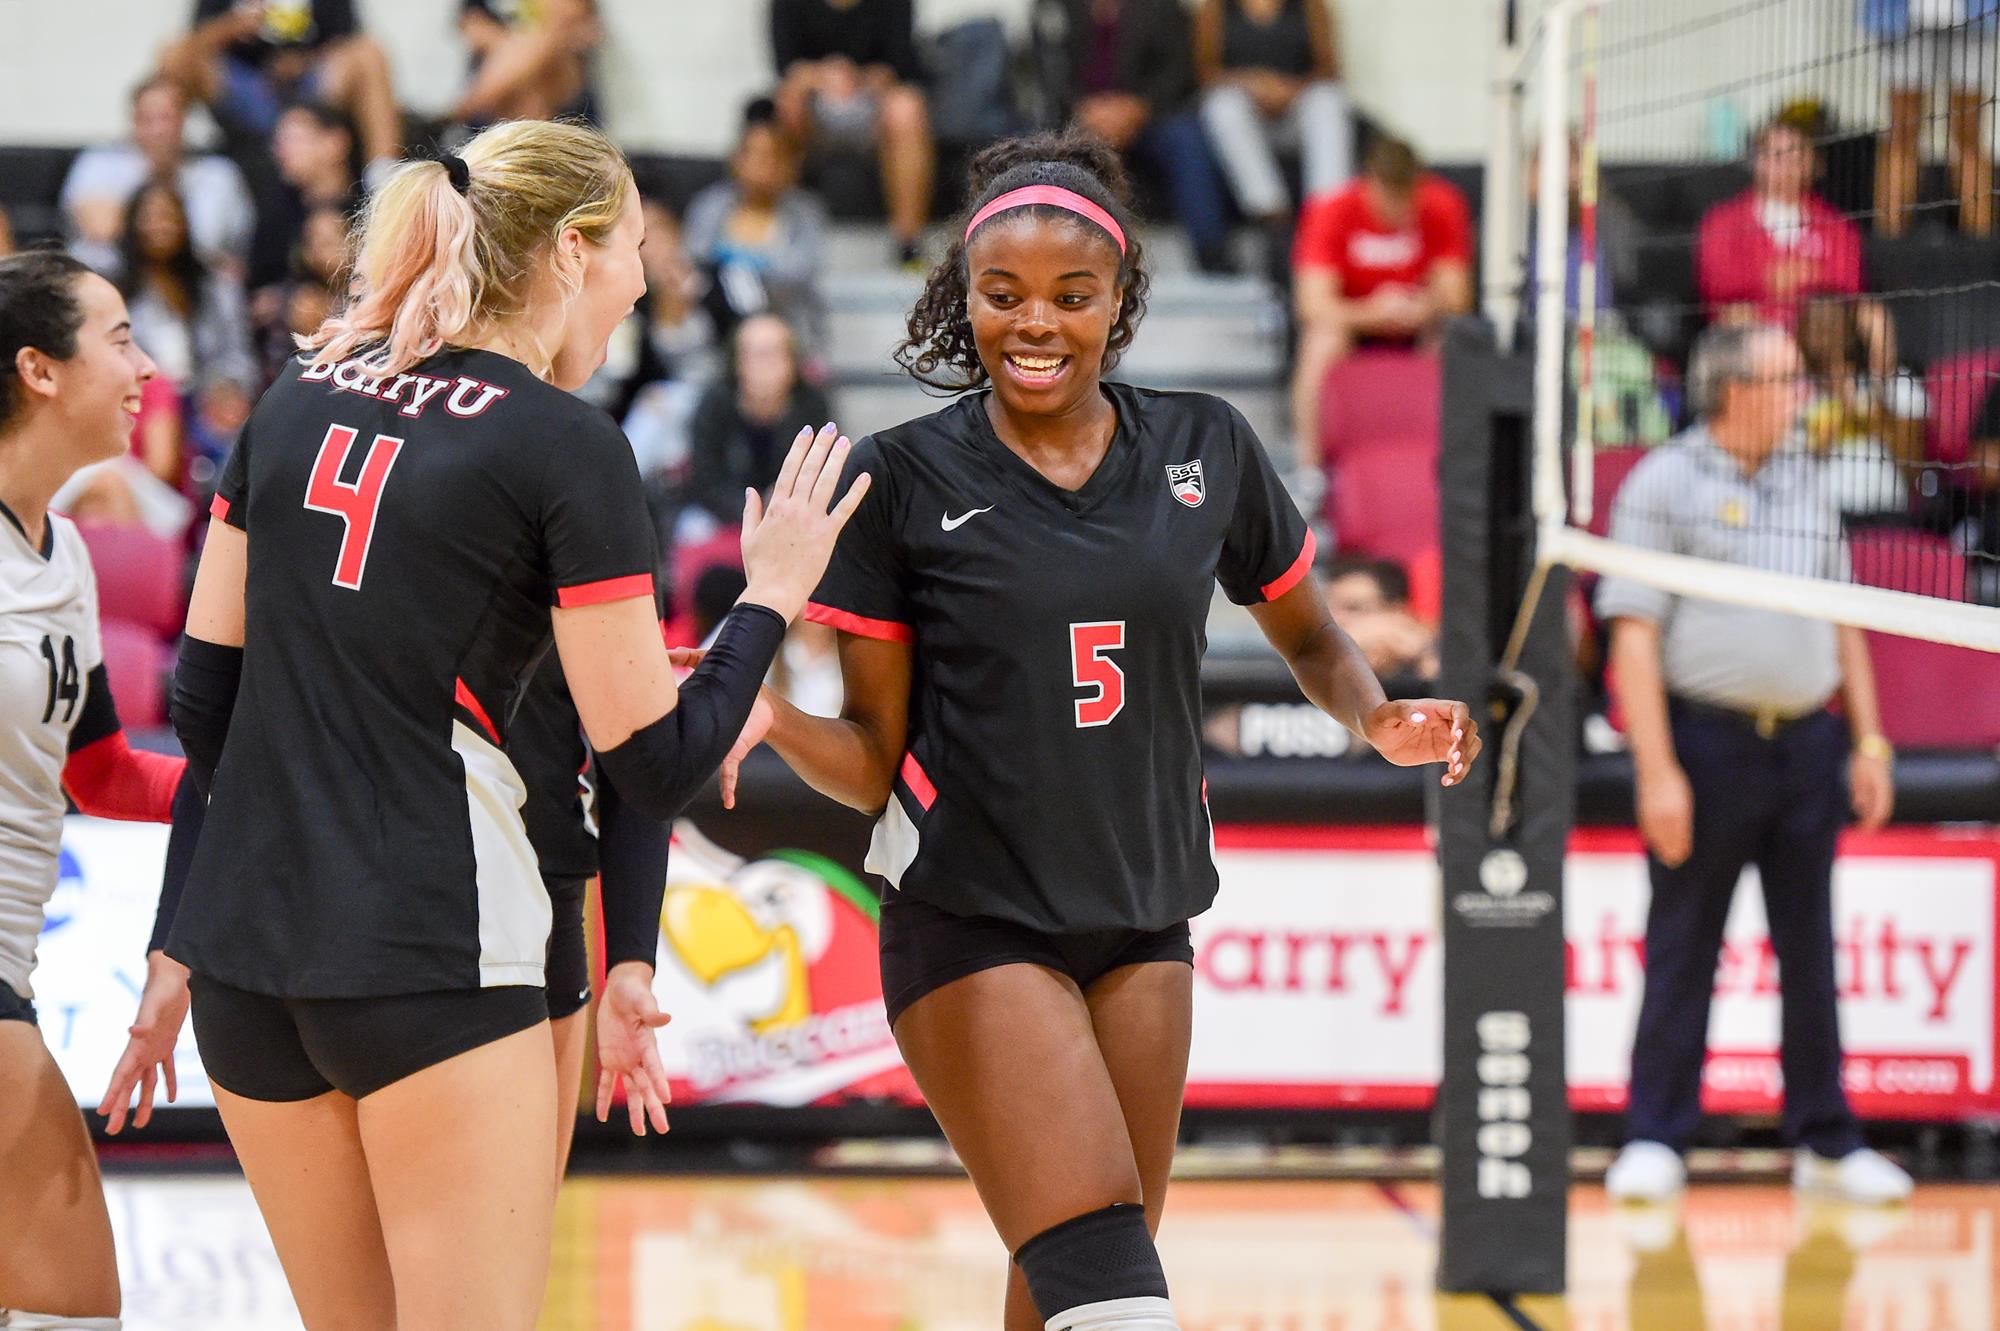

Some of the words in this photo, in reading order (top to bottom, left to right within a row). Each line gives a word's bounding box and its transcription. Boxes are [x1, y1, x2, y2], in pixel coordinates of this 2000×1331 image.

[444, 375, 510, 418] U
[303, 423, 405, 591] 4
[1171, 464, 1200, 479] SSC
[40, 634, 79, 724] 14
[1069, 620, 1126, 728] 5
[1193, 928, 1428, 1018] arry
